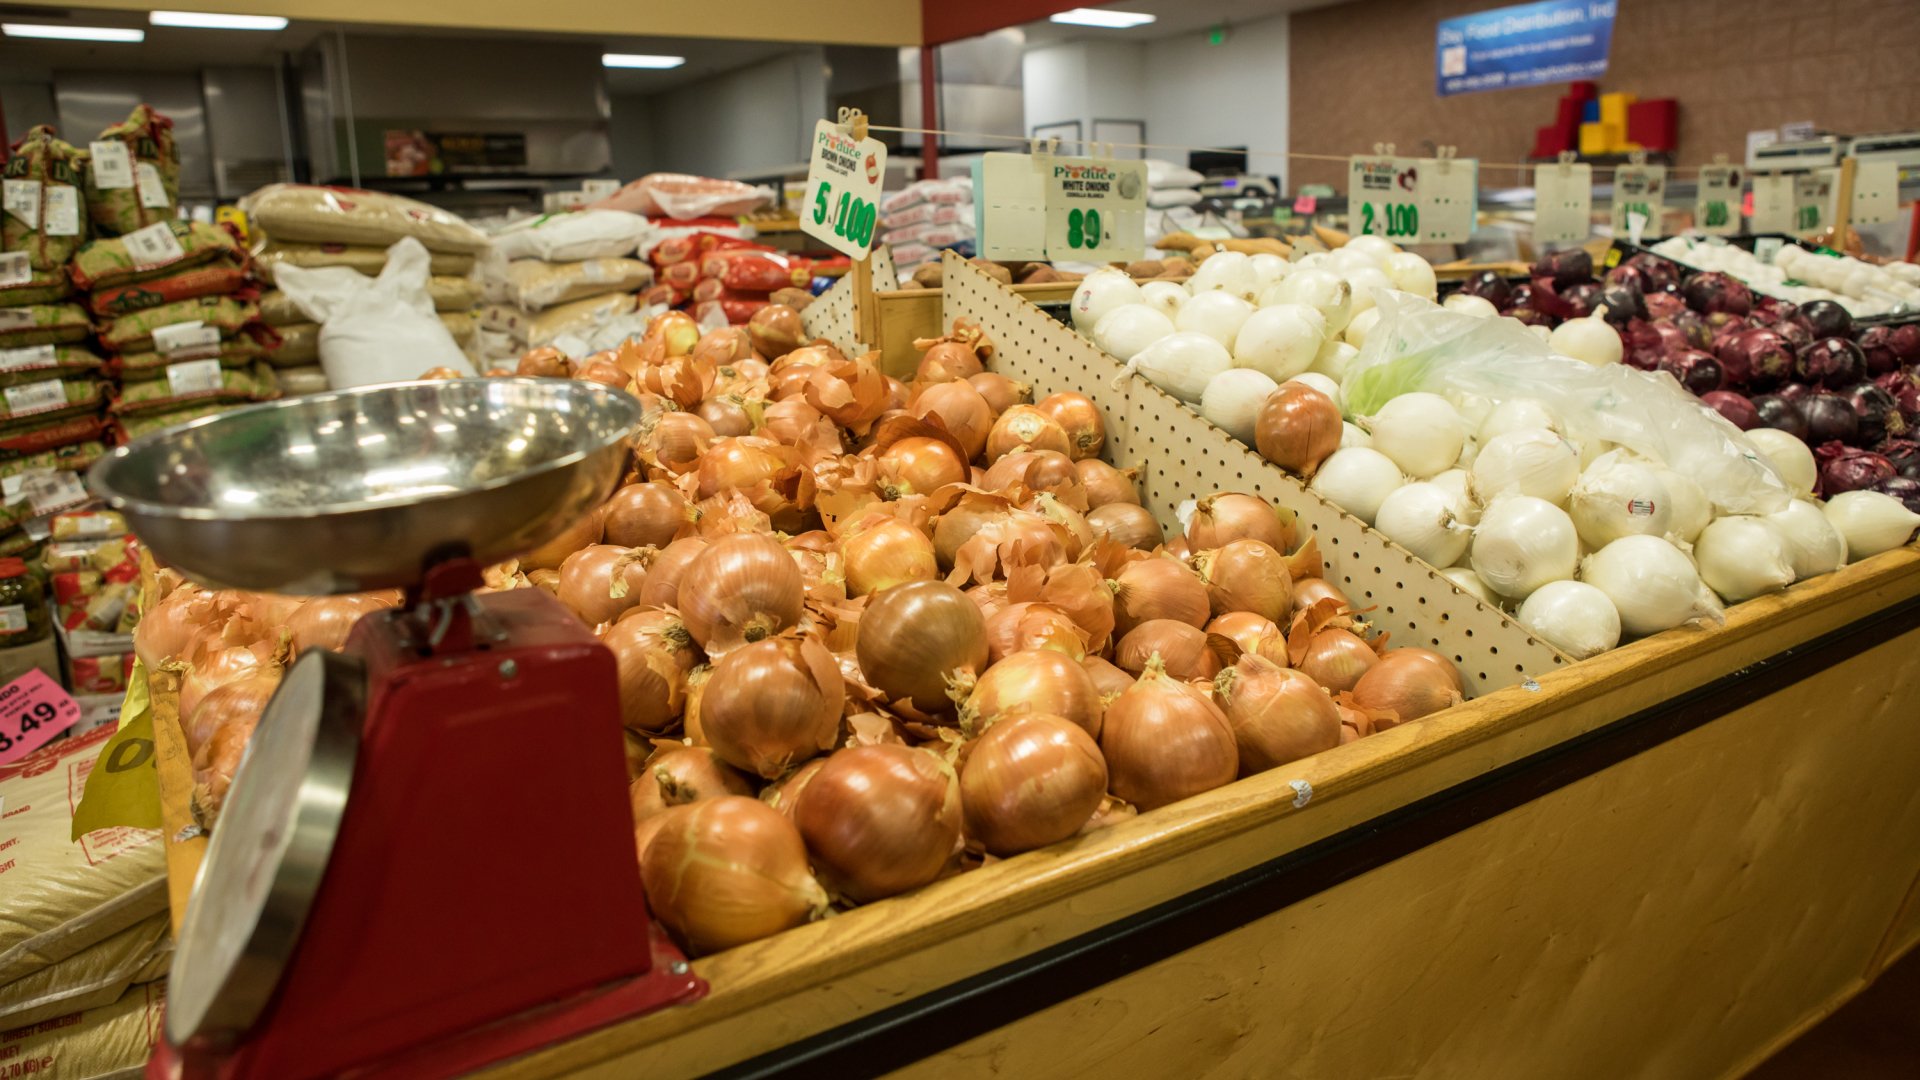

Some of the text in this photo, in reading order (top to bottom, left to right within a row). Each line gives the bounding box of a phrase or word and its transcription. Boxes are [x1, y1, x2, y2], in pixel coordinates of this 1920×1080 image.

[818, 131, 862, 160] Produce
[1053, 165, 1117, 181] Produce
[1062, 180, 1110, 192] WHITE ONIONS
[813, 181, 877, 248] 5 100
[1067, 208, 1100, 249] 89
[1362, 202, 1418, 237] 2 100
[2, 804, 31, 820] BRAND
[2, 1011, 84, 1043] DIRECT SUNLIGHT
